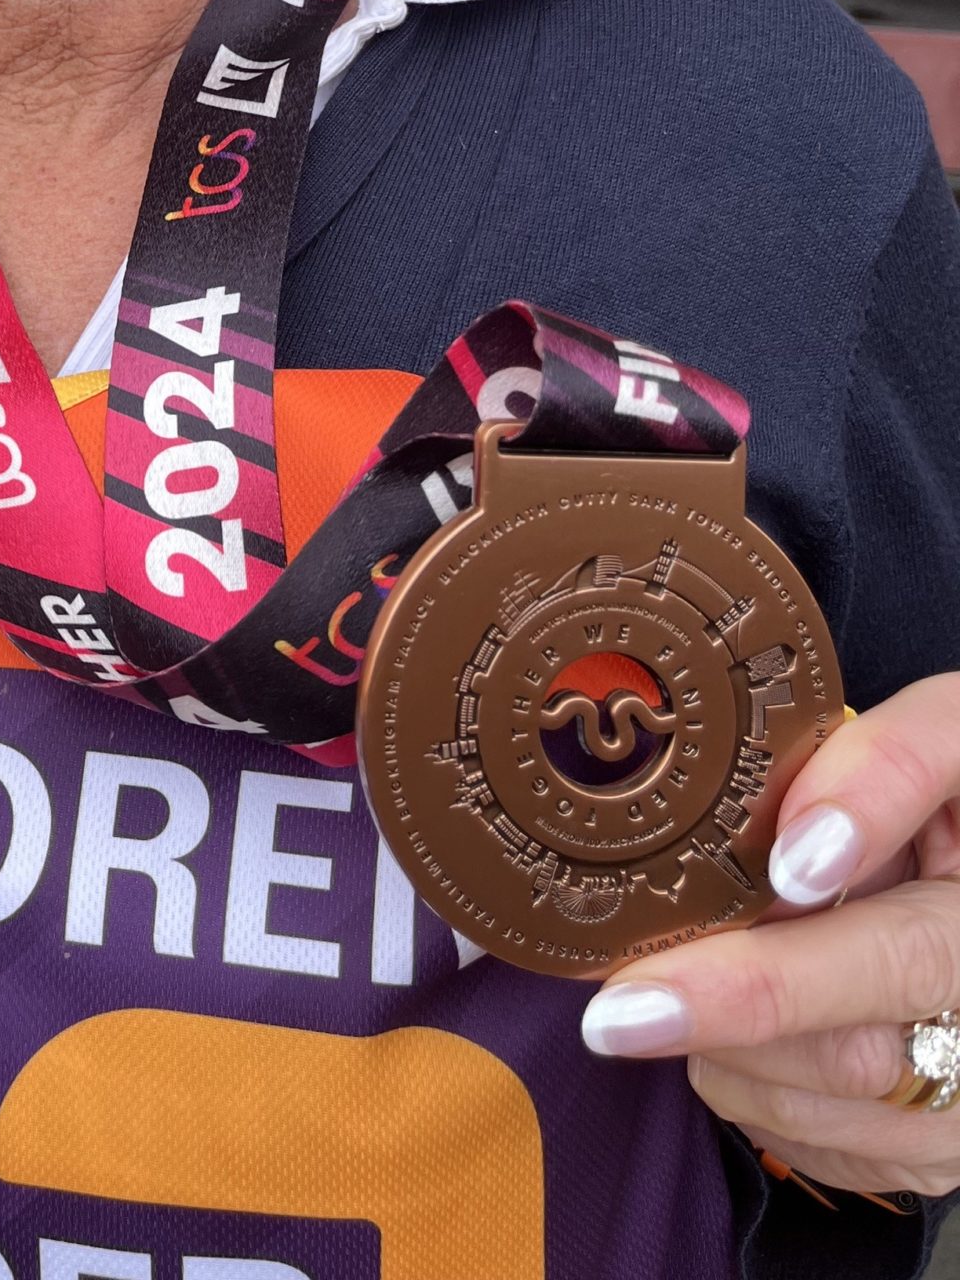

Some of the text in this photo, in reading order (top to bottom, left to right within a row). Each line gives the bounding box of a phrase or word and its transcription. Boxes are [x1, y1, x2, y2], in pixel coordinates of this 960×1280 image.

[143, 285, 248, 599] 2024
[394, 592, 436, 669] PALACE
[439, 492, 827, 700] BLACKHEATH CUTTY SARK TOWER BRIDGE CANARY
[384, 680, 412, 821] BUCKINGHAM
[511, 622, 704, 827] WE FINISHED TOGETHER
[408, 829, 496, 929] PARLIAMENT
[501, 926, 526, 945] OF
[536, 938, 610, 962] HOUSES
